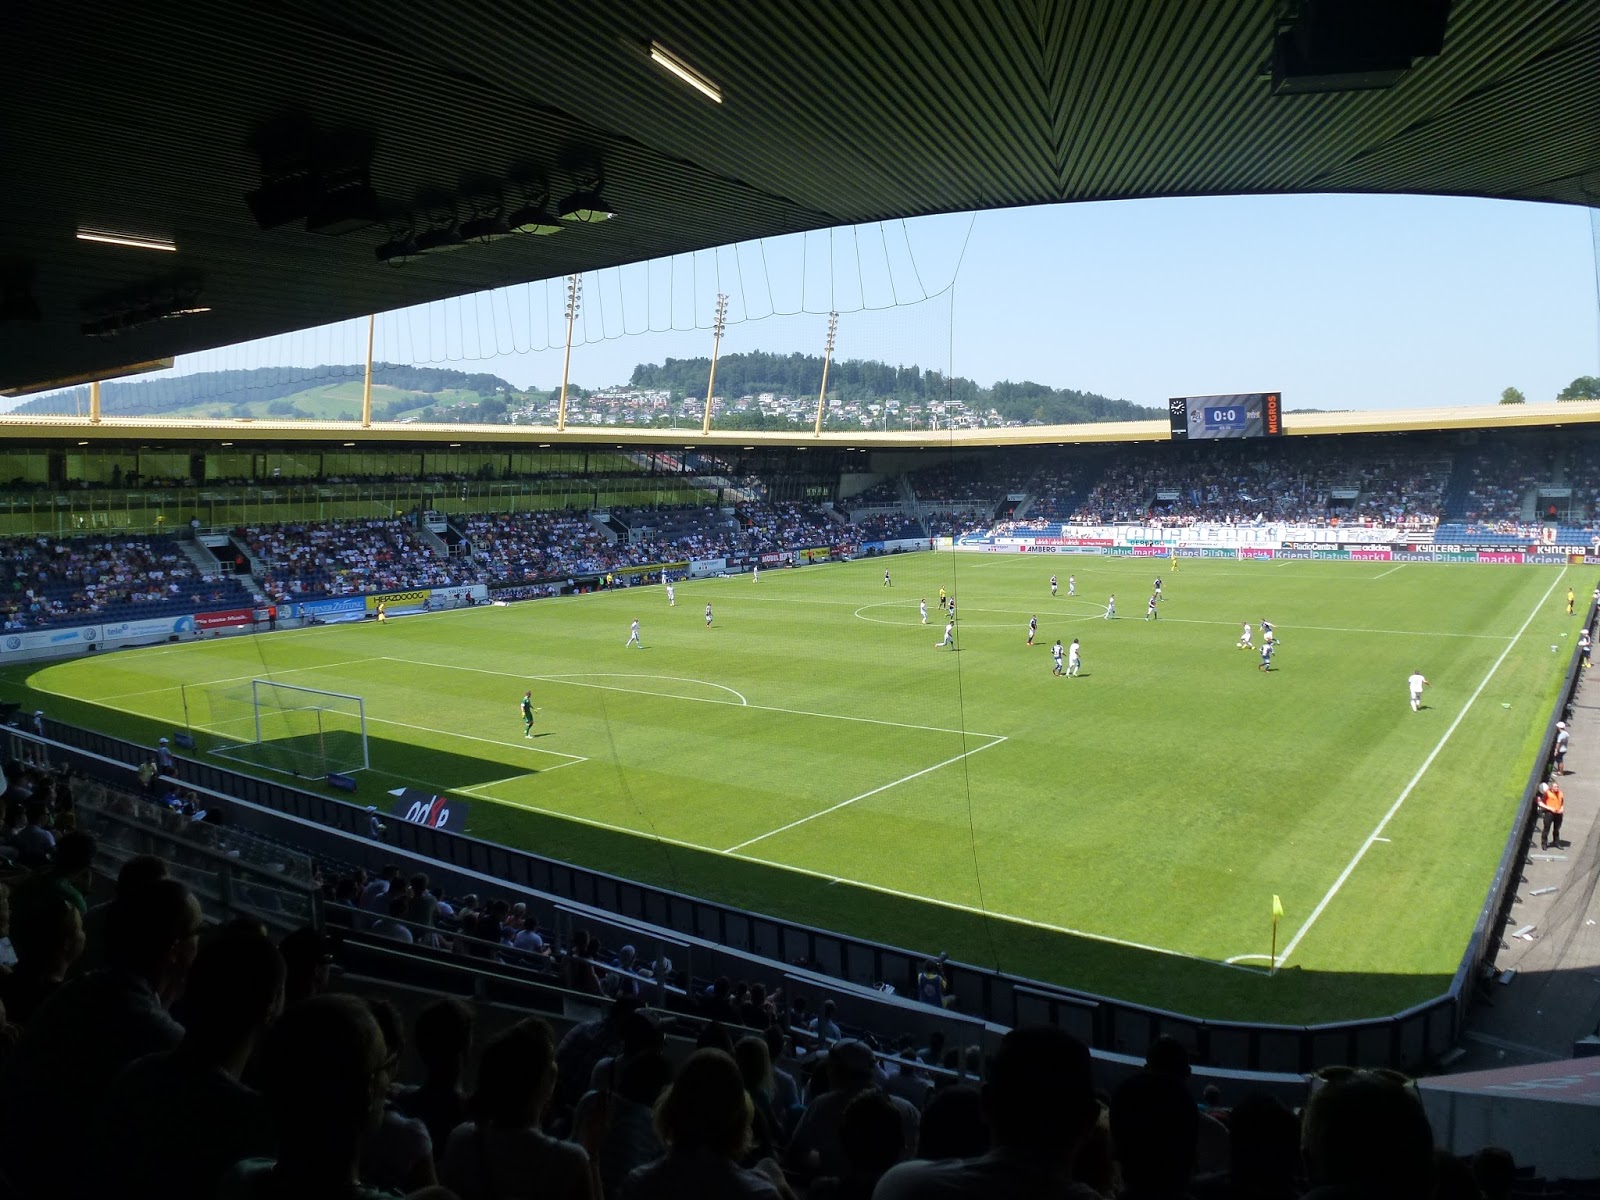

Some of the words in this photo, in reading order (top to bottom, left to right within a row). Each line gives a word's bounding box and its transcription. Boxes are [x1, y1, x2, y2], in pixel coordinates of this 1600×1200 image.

[1213, 410, 1236, 421] 0:0
[1268, 395, 1278, 434] MIGROS
[1103, 547, 1133, 555] Pilatus
[1537, 546, 1586, 554] KYOCERA
[1276, 551, 1308, 559] Kriens
[1313, 551, 1350, 560] Pilatus
[1352, 552, 1385, 560] markt
[1394, 552, 1430, 561] Kriens
[1435, 553, 1475, 562] Pilatus
[1480, 555, 1517, 563] markt
[1527, 555, 1567, 564] Kriens
